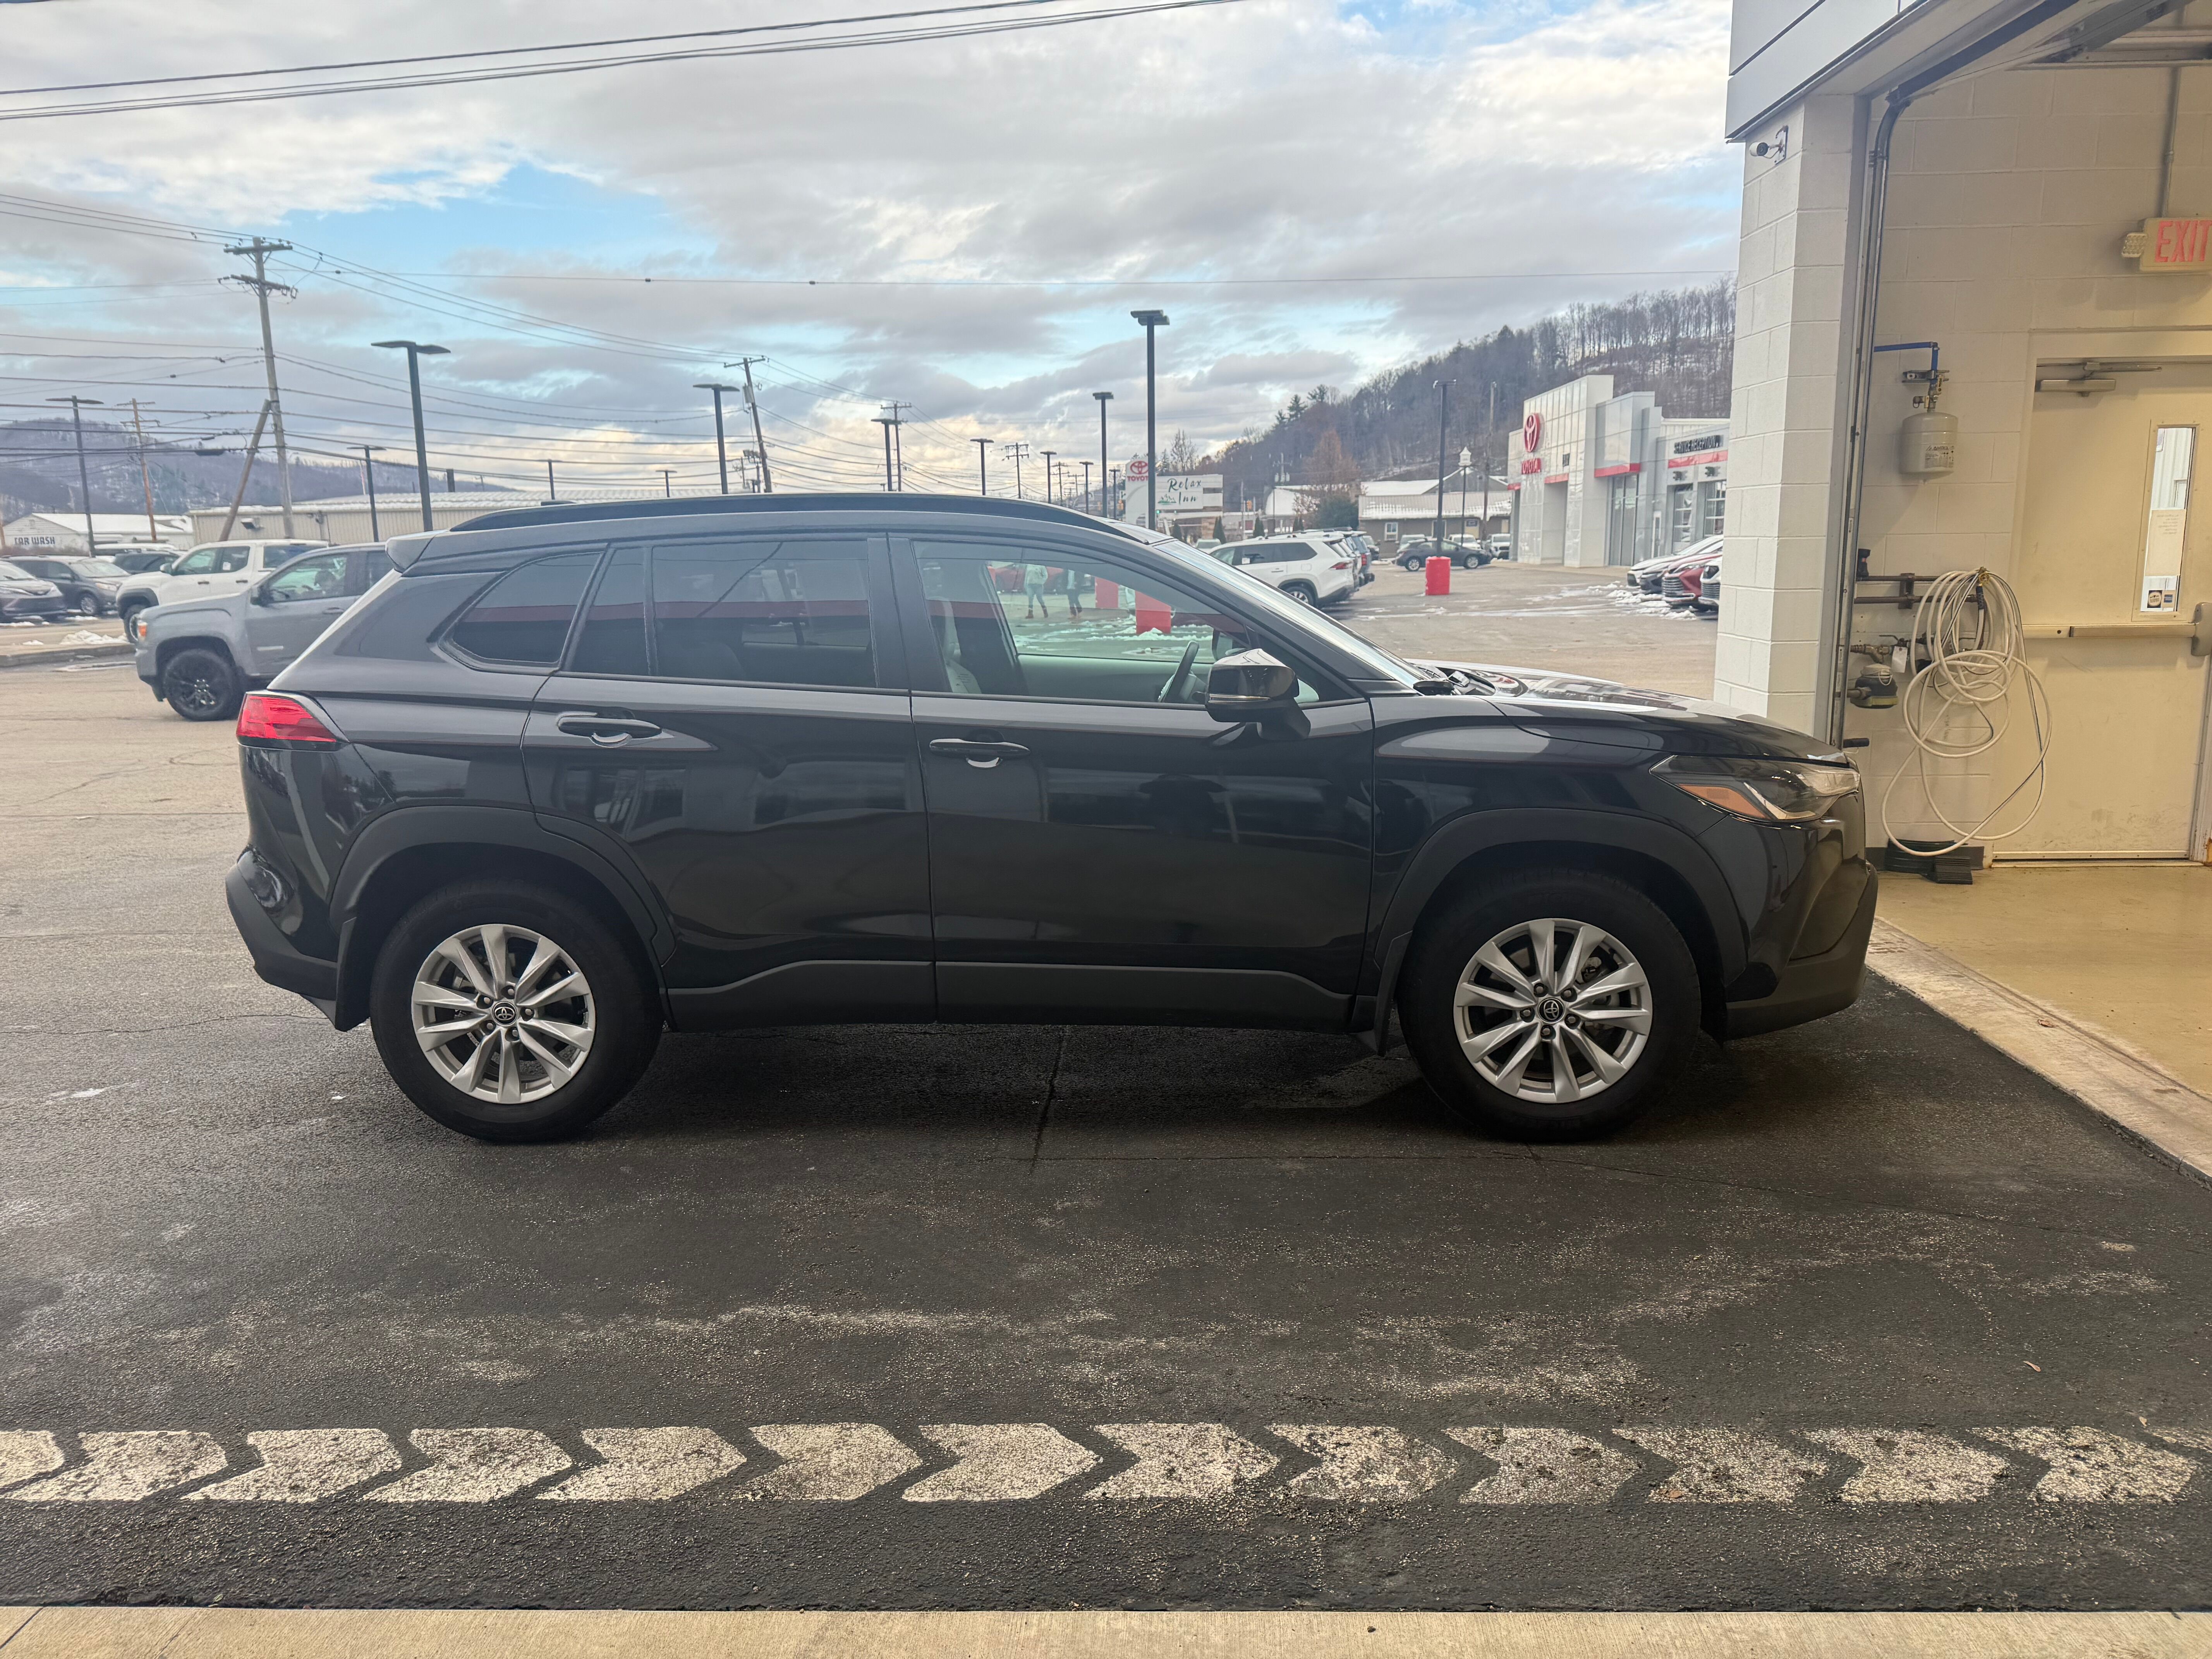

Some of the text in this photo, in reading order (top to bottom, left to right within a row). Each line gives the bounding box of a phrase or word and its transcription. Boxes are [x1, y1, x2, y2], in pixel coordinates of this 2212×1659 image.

[2155, 220, 2212, 262] EXIT
[1167, 477, 1201, 492] Relax
[1178, 491, 1196, 505] Inn
[31, 536, 55, 544] WASH
